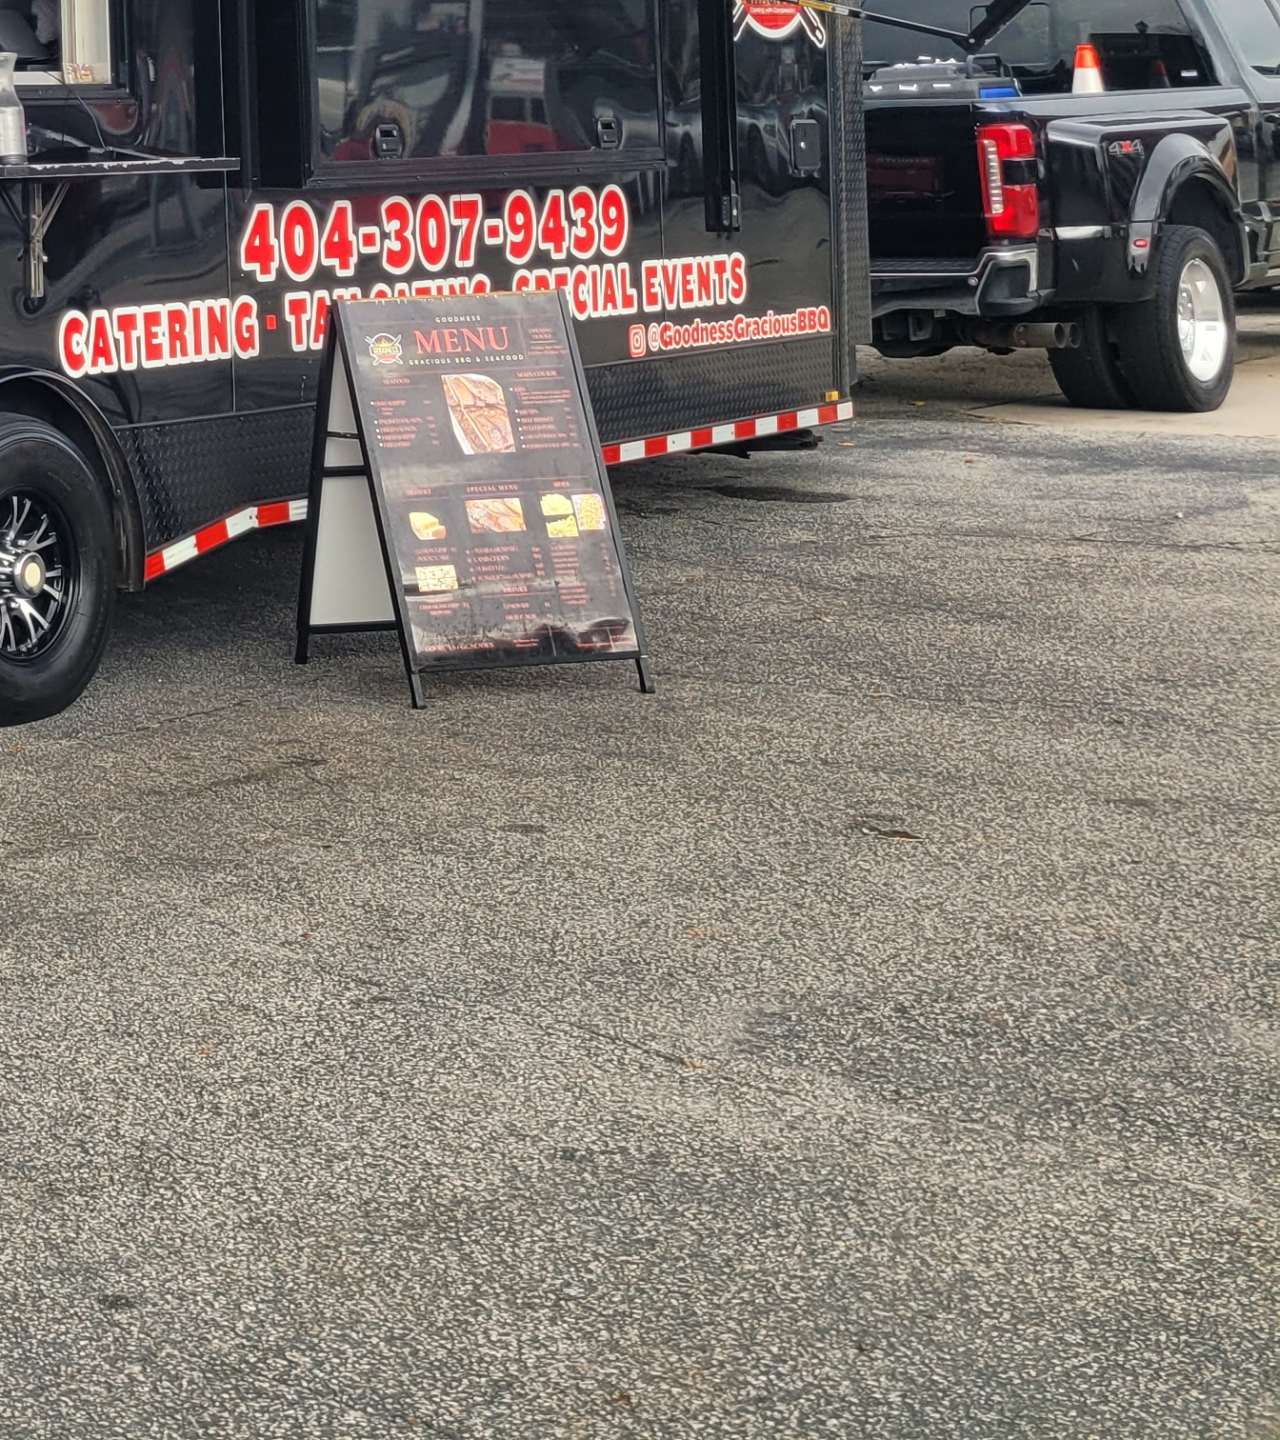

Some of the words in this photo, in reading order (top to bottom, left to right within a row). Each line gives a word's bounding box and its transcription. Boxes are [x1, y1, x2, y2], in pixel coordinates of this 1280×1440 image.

[241, 184, 629, 282] 404-307-9439
[59, 295, 259, 377] CATERING
[641, 252, 747, 312] EVENTS
[414, 326, 508, 354] MENU
[648, 305, 831, 351] @GoodnessGraciousBBQ
